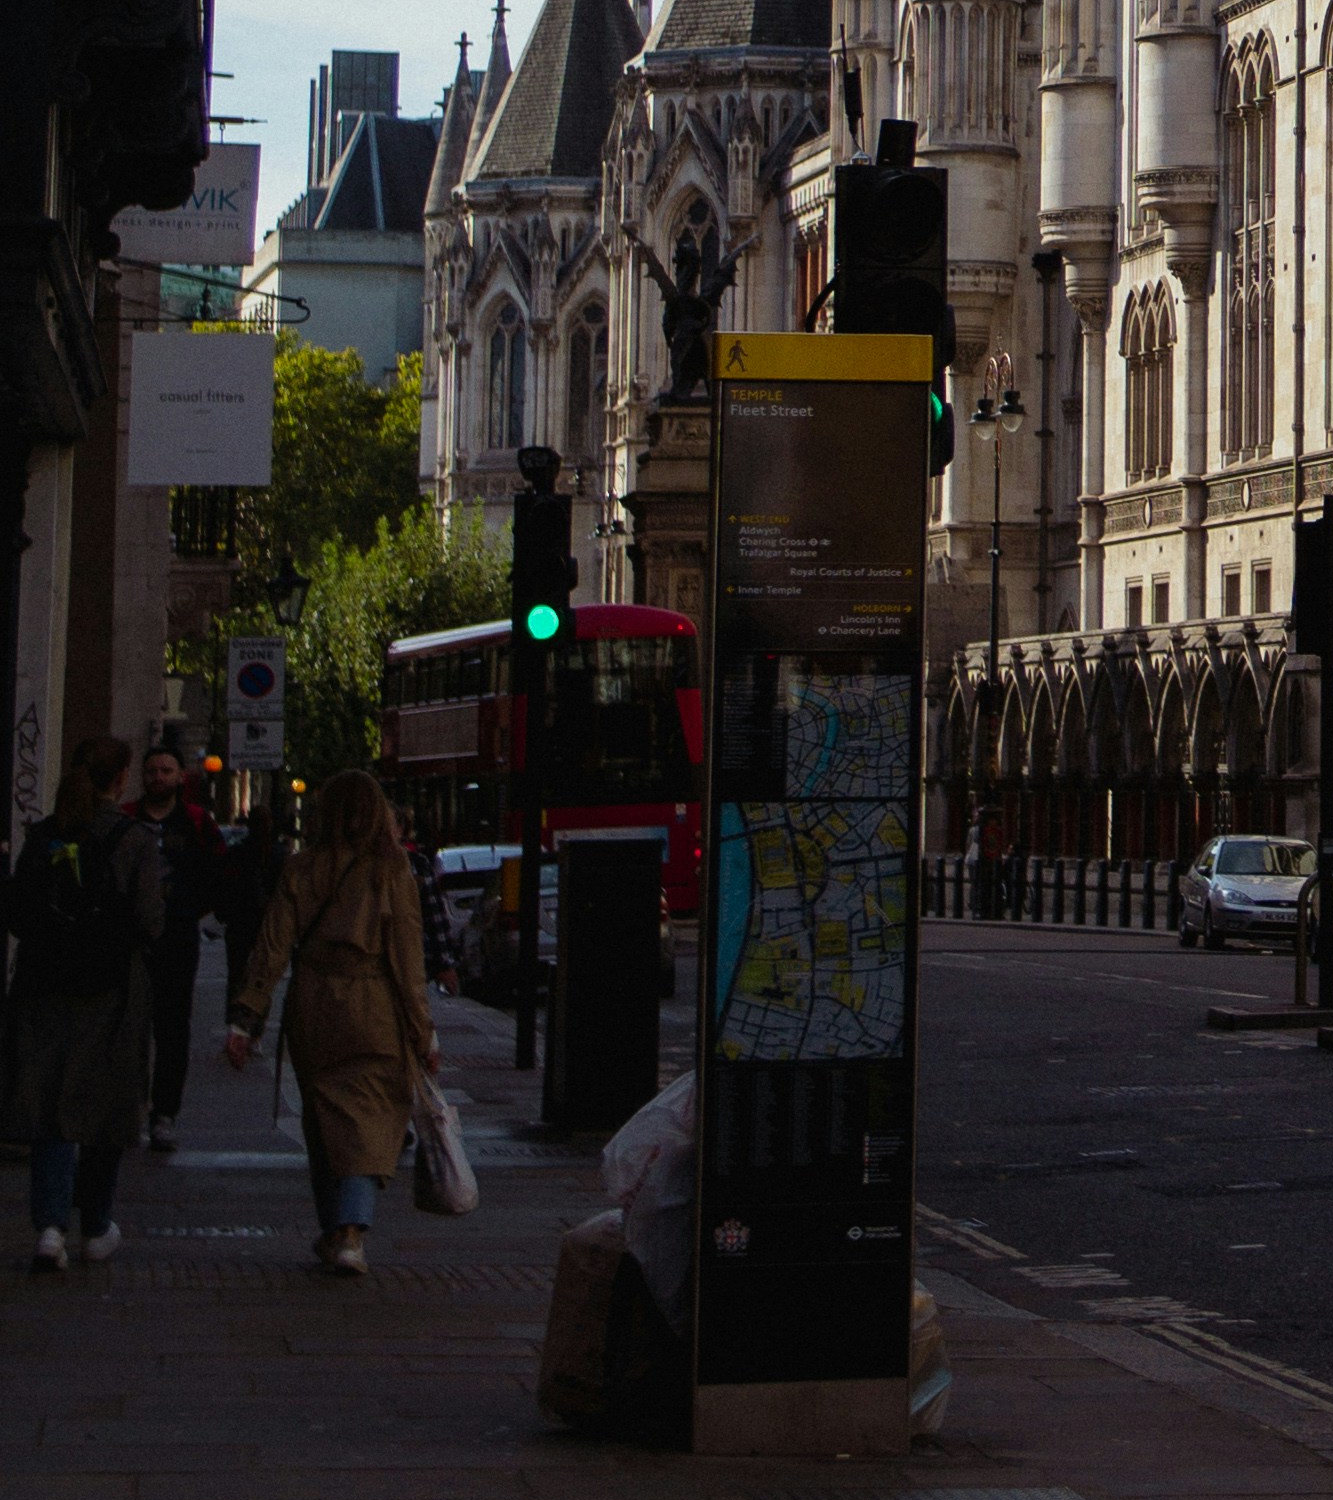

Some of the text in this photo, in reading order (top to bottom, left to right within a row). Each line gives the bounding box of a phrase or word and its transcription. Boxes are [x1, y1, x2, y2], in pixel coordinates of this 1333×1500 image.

[207, 220, 241, 231] print
[159, 389, 245, 402] casual fitters
[730, 389, 783, 401] TEMPLE
[730, 404, 814, 417] Fleet Street
[739, 526, 781, 536] Aldwych
[739, 537, 806, 548] Charing Cross
[739, 548, 818, 558] Trafalgar Square
[790, 567, 902, 578] Royal Courts of Justice
[738, 585, 802, 596] Inner Temple
[853, 604, 902, 613] HOLBORN
[840, 615, 901, 624] Lincoln's Inn
[830, 626, 901, 636] Chancery Lane
